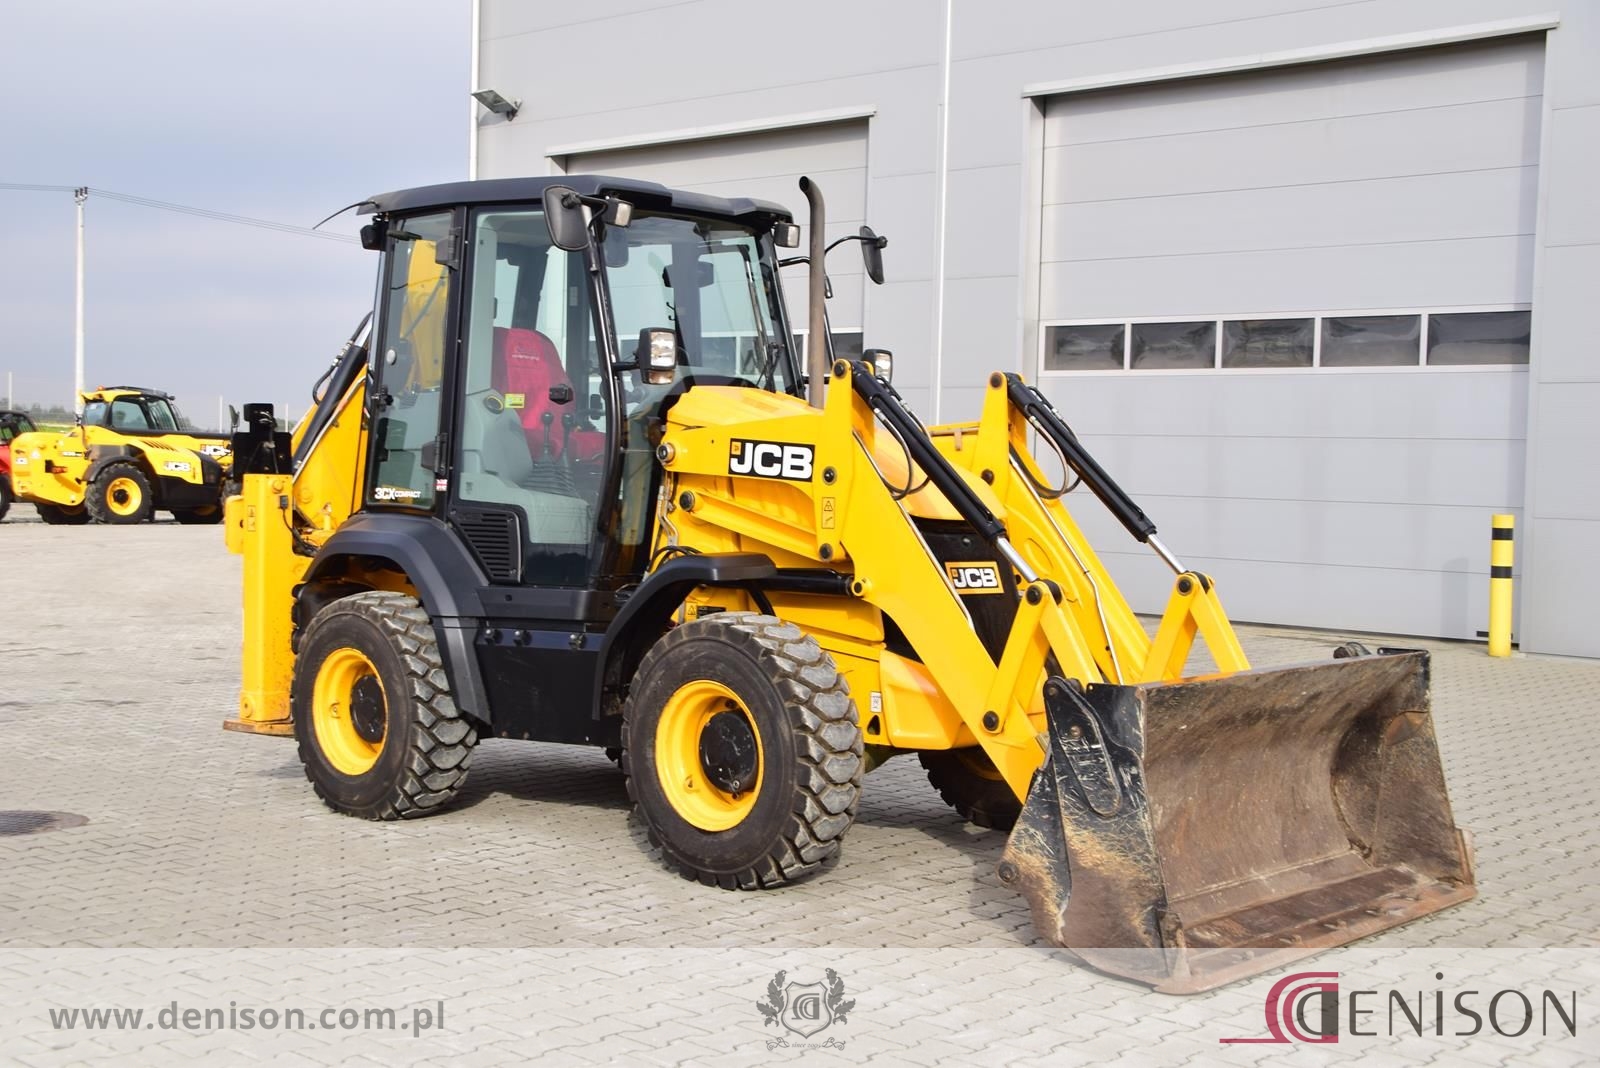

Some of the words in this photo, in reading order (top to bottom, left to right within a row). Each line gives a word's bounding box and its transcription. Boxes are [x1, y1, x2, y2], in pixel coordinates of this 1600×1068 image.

[730, 442, 813, 479] JCB
[374, 487, 395, 499] 3CX
[953, 568, 998, 587] JCB
